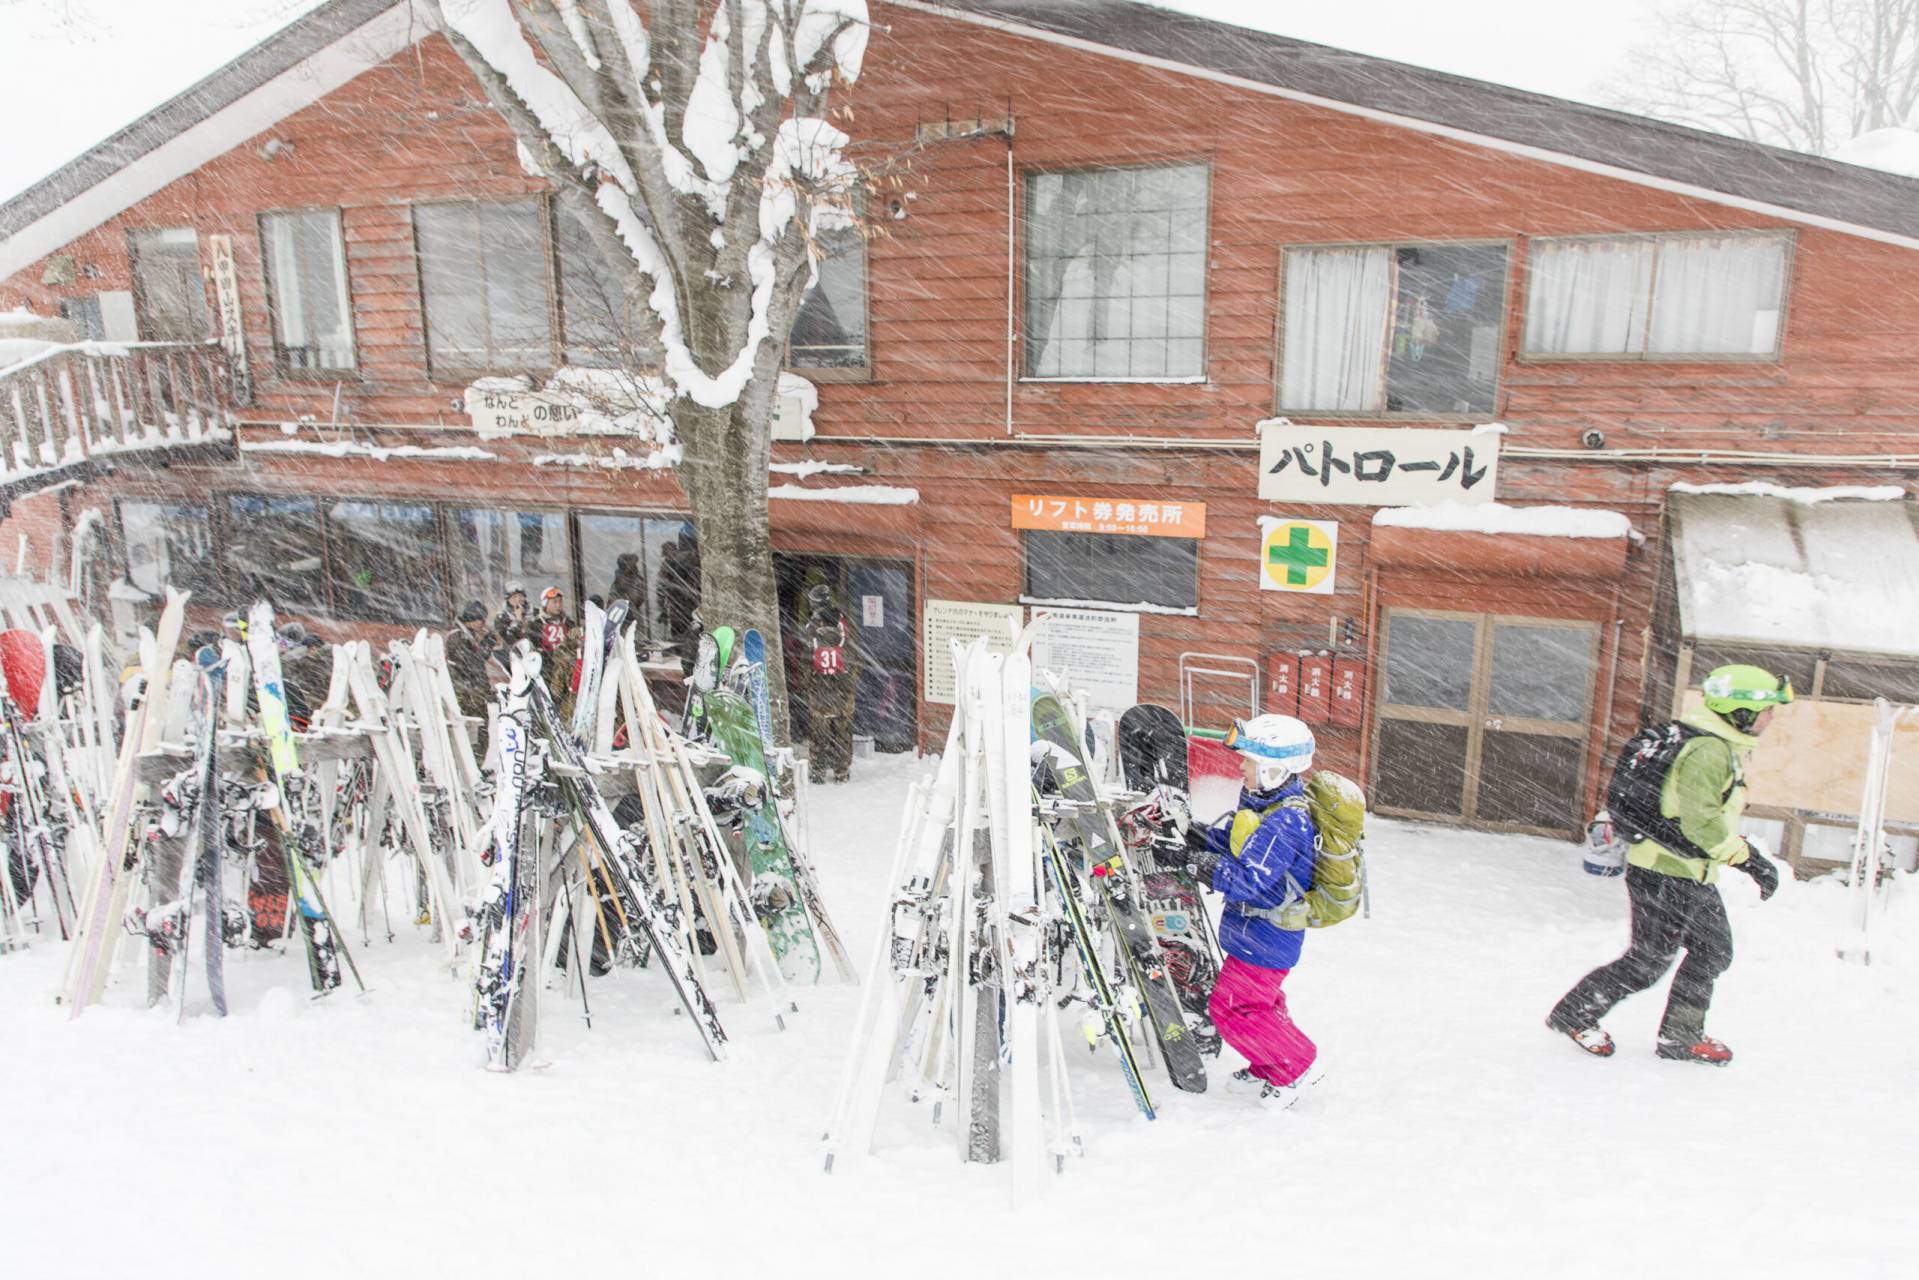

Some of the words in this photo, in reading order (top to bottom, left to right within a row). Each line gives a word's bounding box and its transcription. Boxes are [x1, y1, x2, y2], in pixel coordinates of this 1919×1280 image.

[1268, 439, 1488, 490] パトロール
[1029, 499, 1183, 525] リフト券発売所
[548, 626, 565, 642] 24
[820, 650, 837, 668] 31
